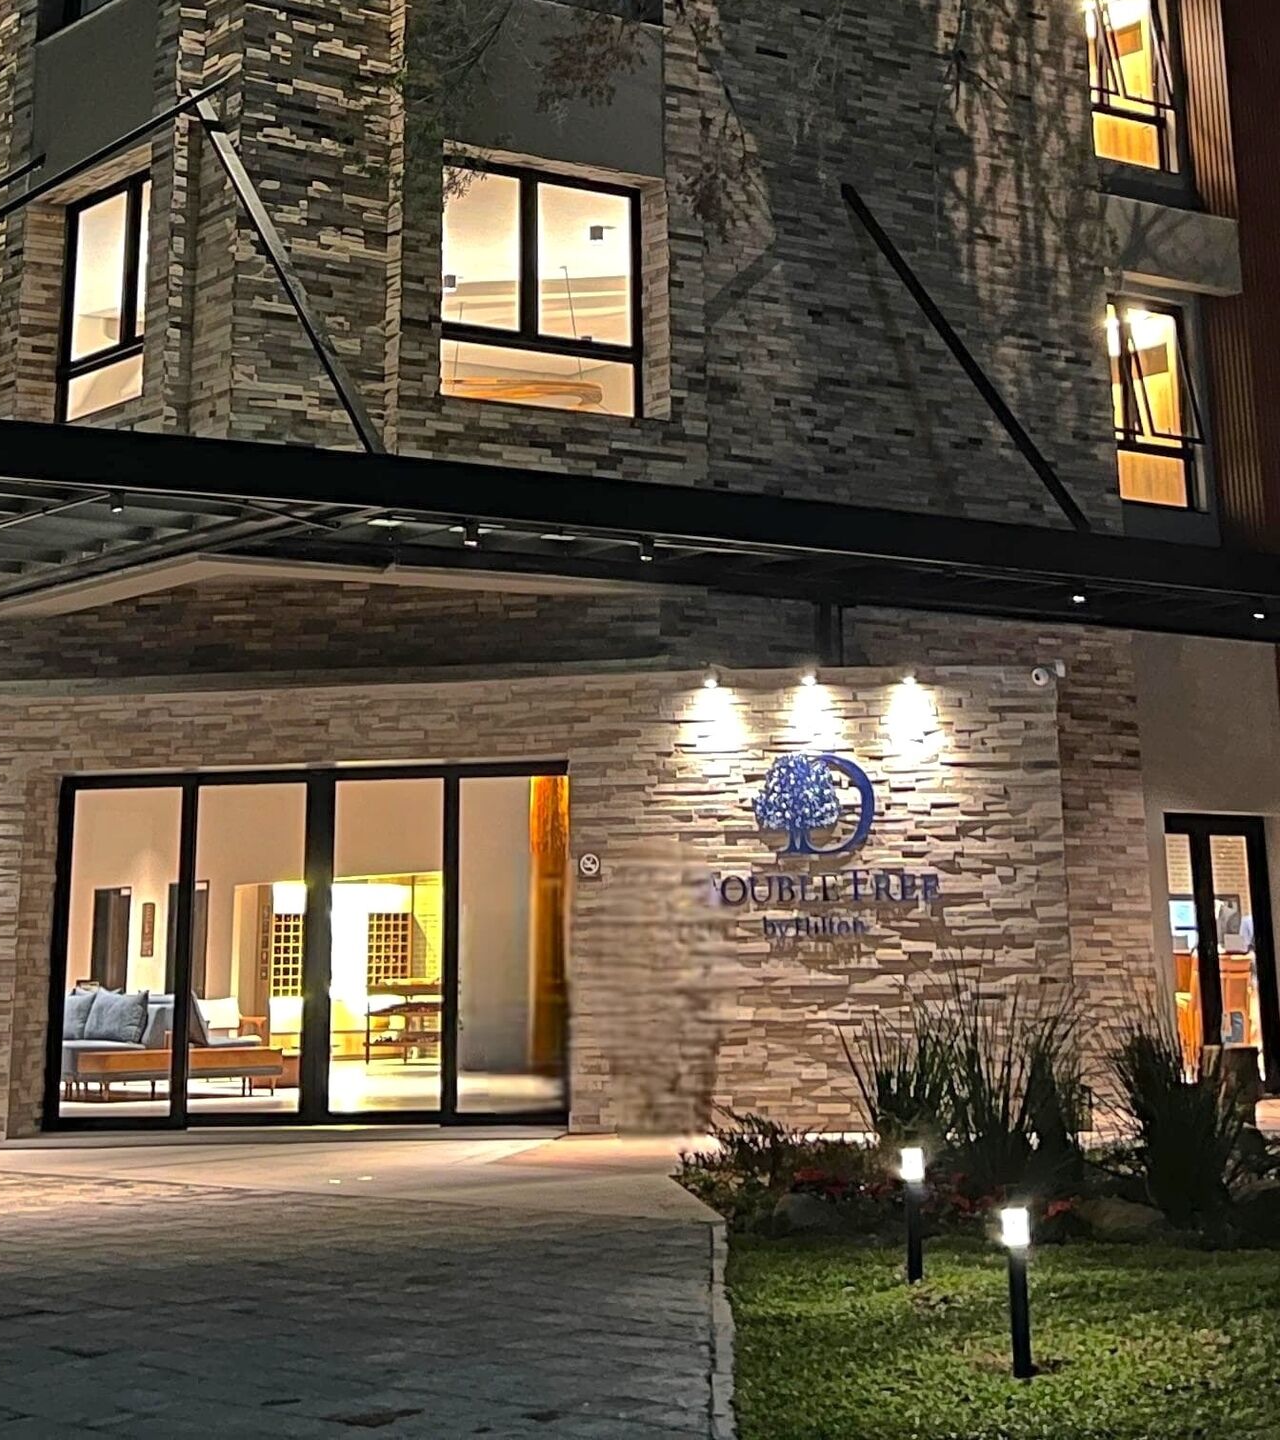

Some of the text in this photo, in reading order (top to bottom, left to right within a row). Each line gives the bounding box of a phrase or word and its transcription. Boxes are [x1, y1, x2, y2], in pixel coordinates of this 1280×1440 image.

[710, 869, 939, 906] OUBLETREE
[763, 914, 866, 939] by Hilton
